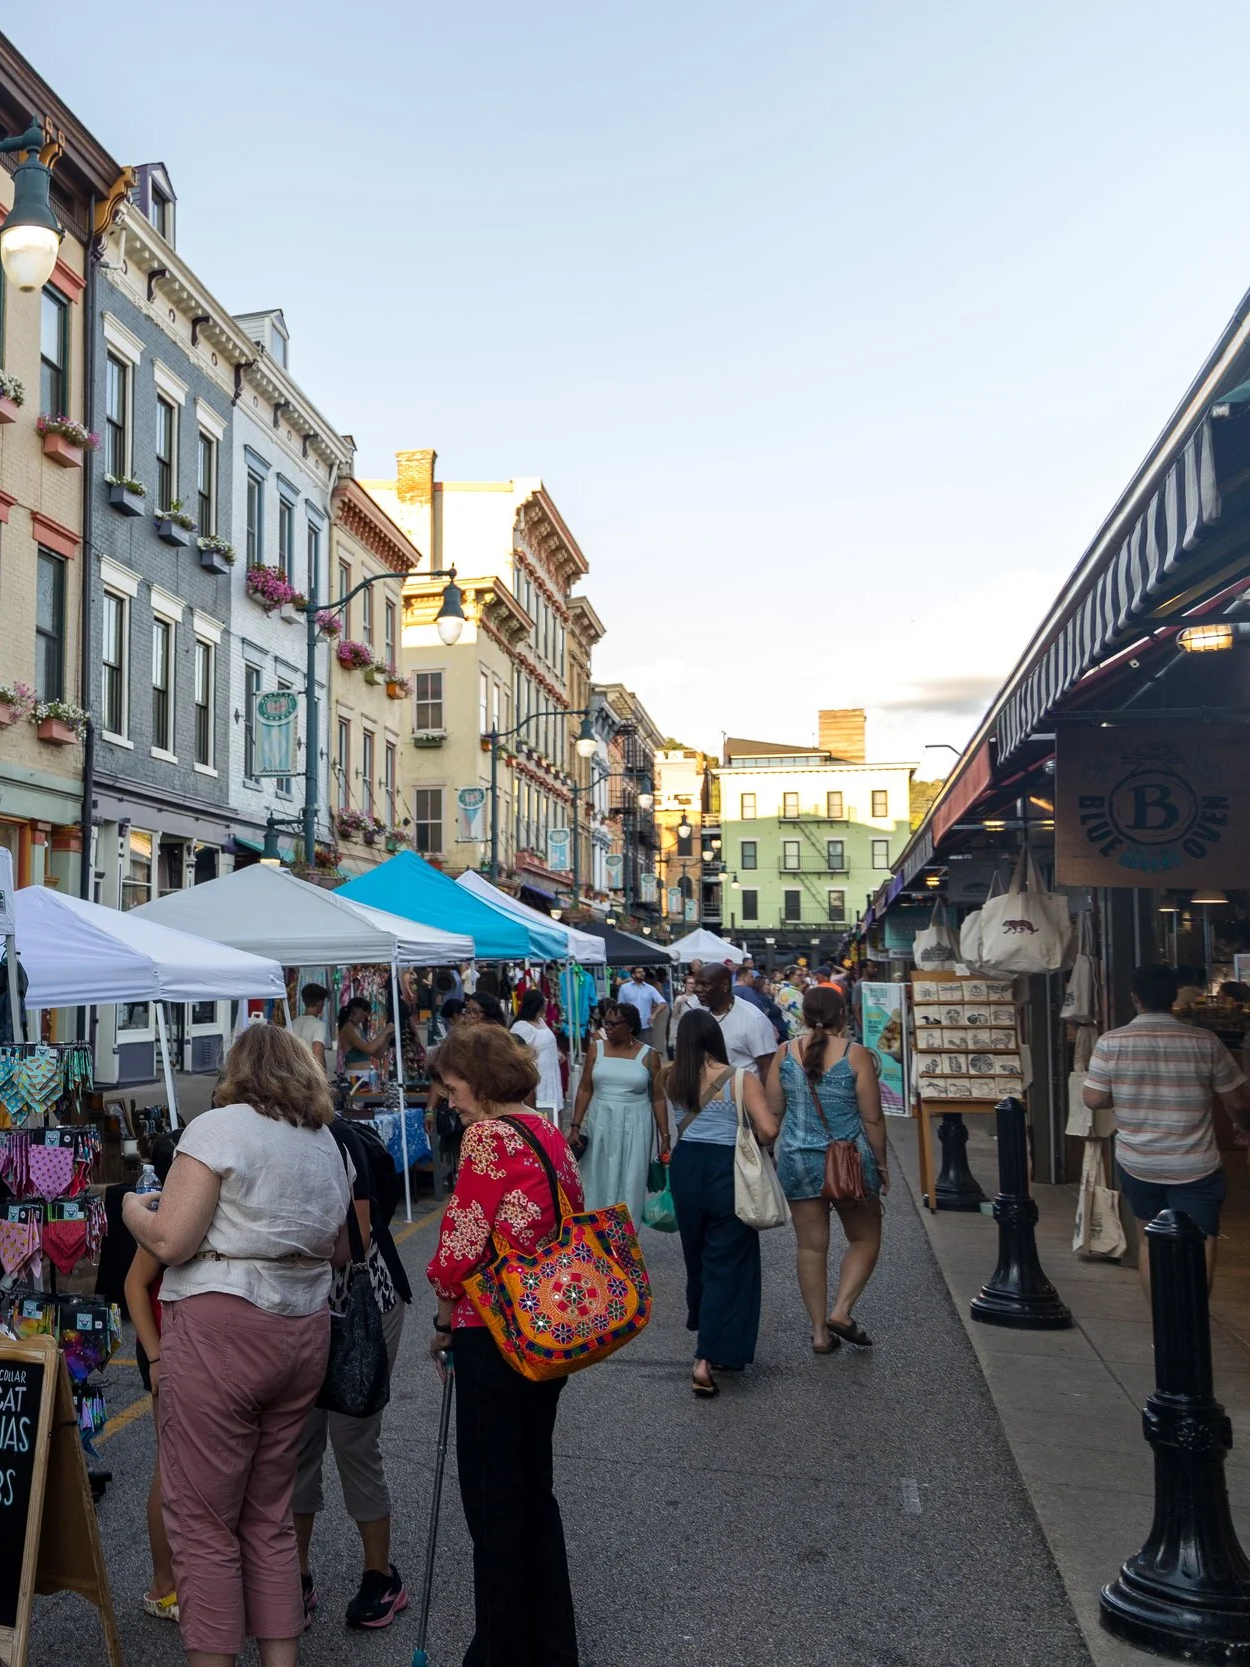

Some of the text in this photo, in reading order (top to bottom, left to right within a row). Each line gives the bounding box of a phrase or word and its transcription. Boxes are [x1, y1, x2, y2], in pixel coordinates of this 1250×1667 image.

[1078, 795, 1124, 858] BLUE
[1125, 783, 1180, 829] B
[1182, 795, 1230, 859] OVEN
